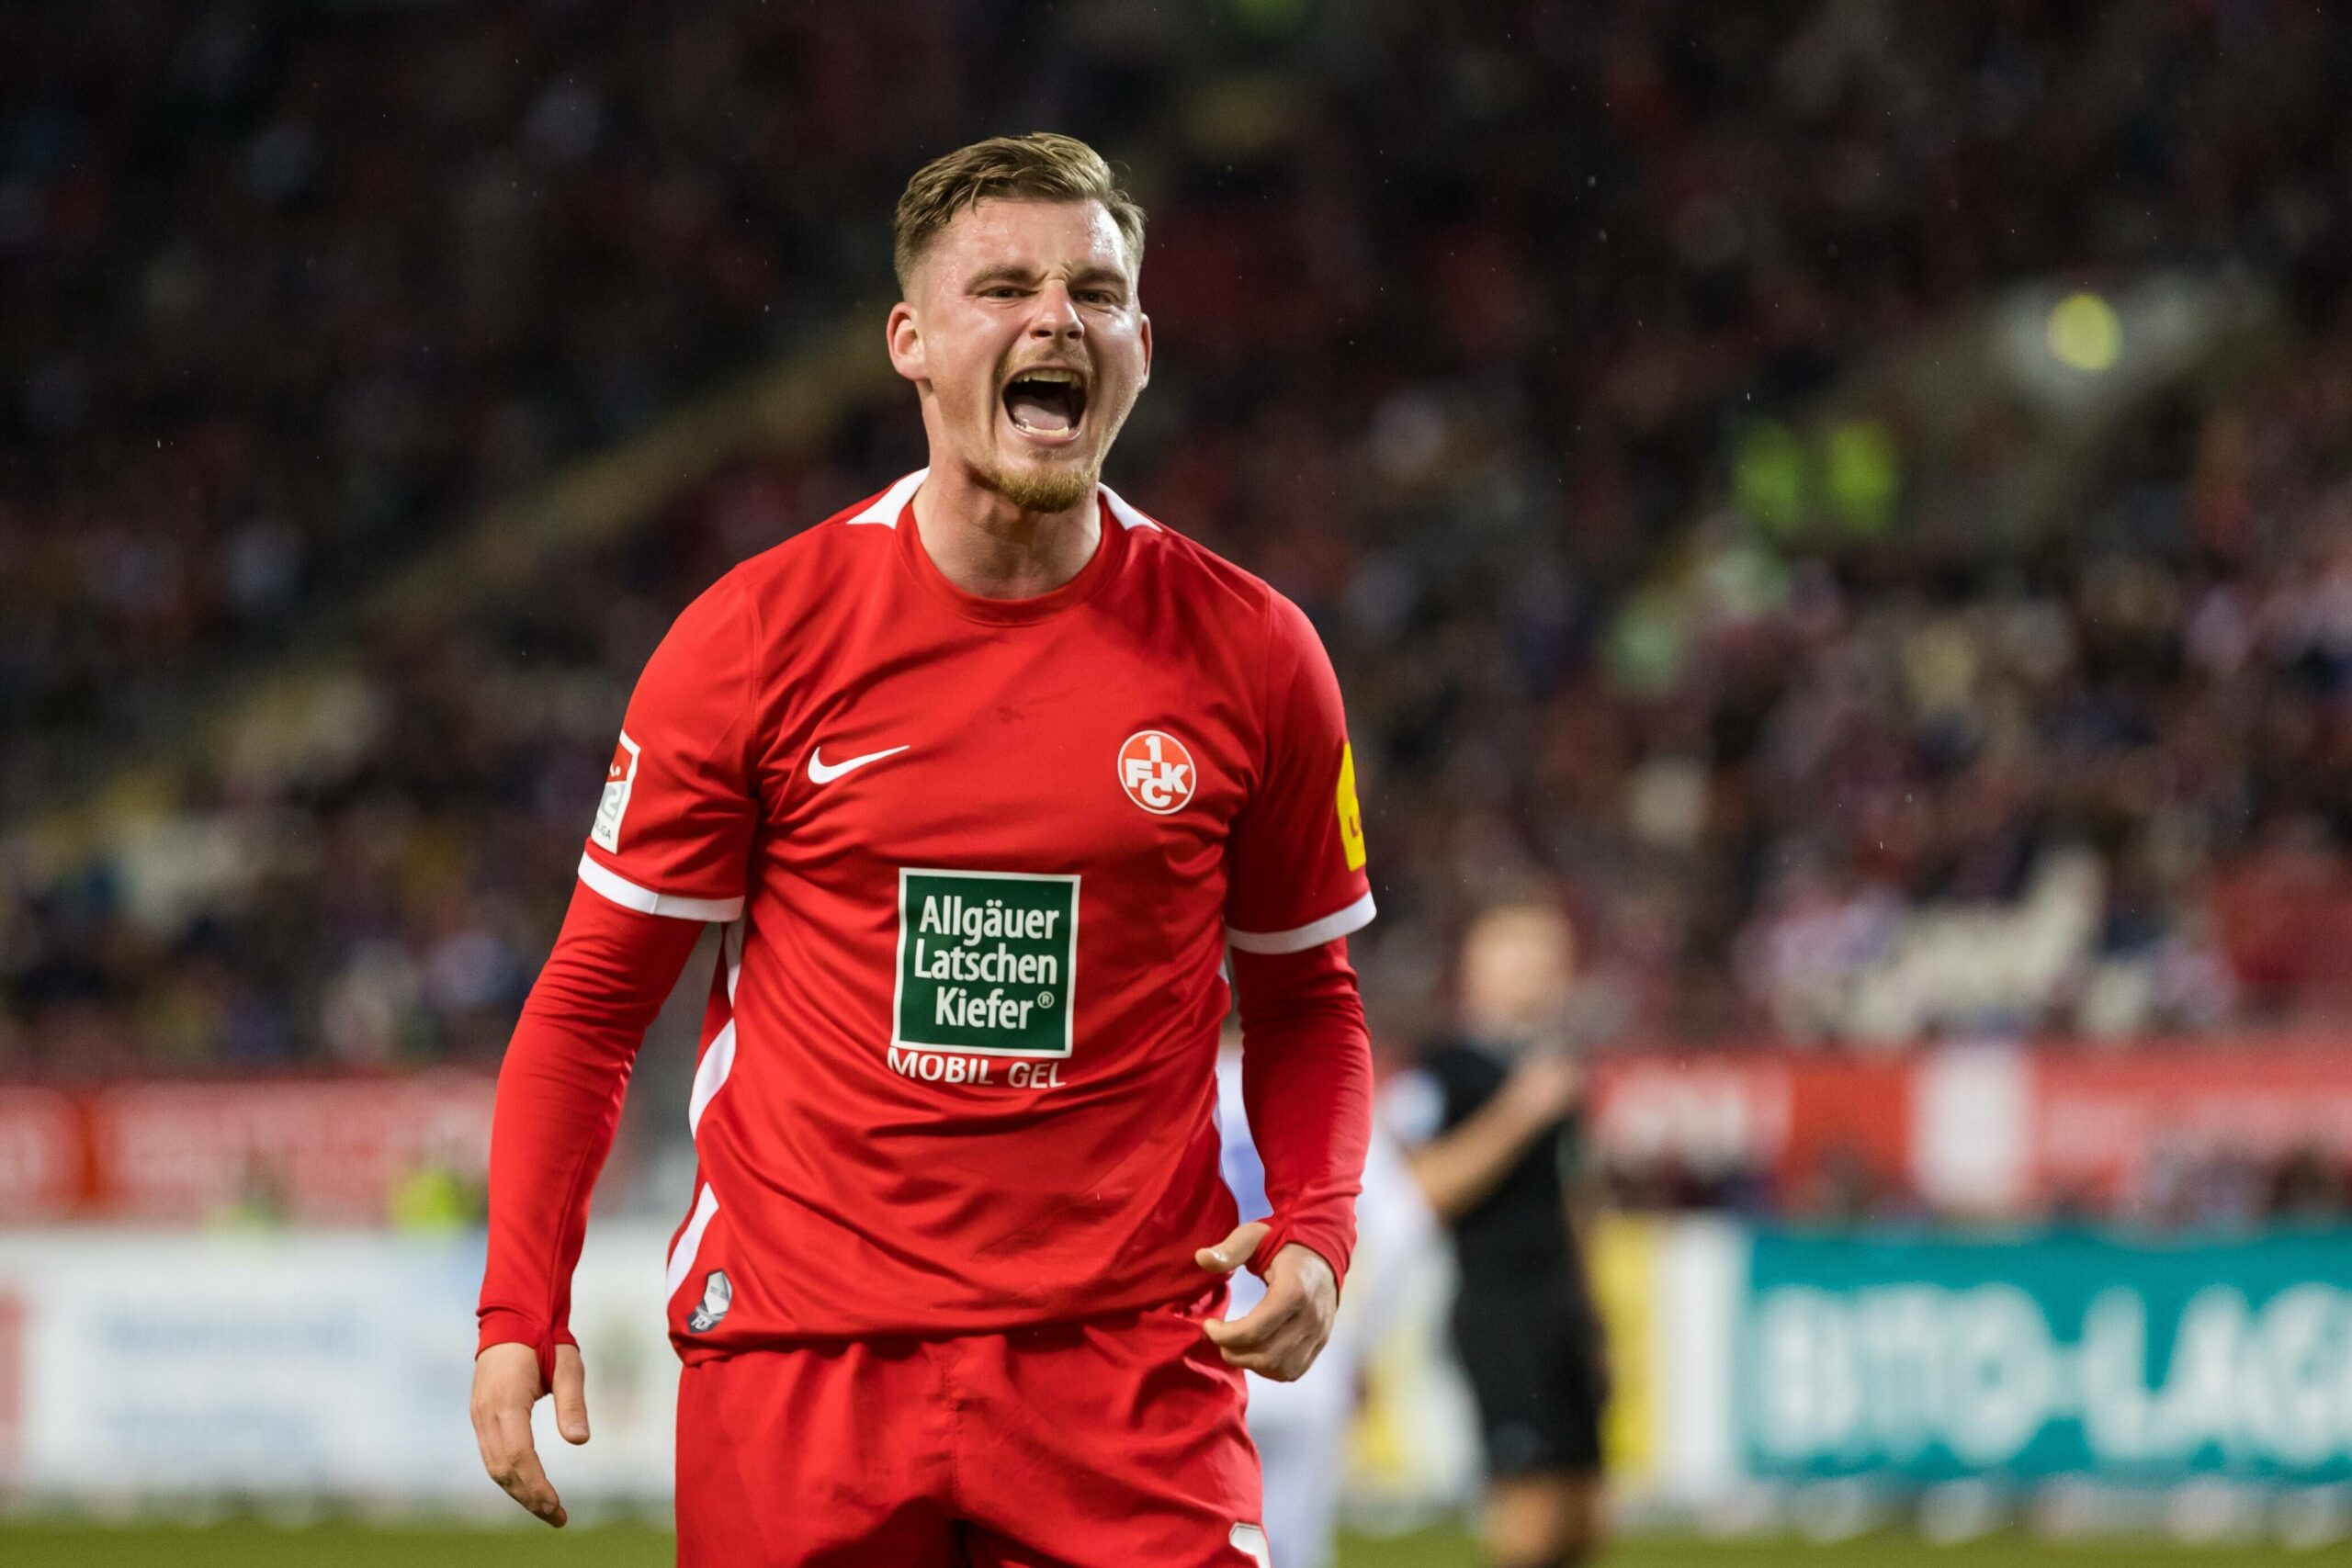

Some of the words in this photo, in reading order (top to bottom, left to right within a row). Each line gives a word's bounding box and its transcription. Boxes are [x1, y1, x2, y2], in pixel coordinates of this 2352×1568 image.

[919, 895, 1059, 946] Allgäuer
[914, 938, 1057, 985] Latschen
[887, 1046, 994, 1085] MOBIL
[1008, 1061, 1067, 1089] GEL
